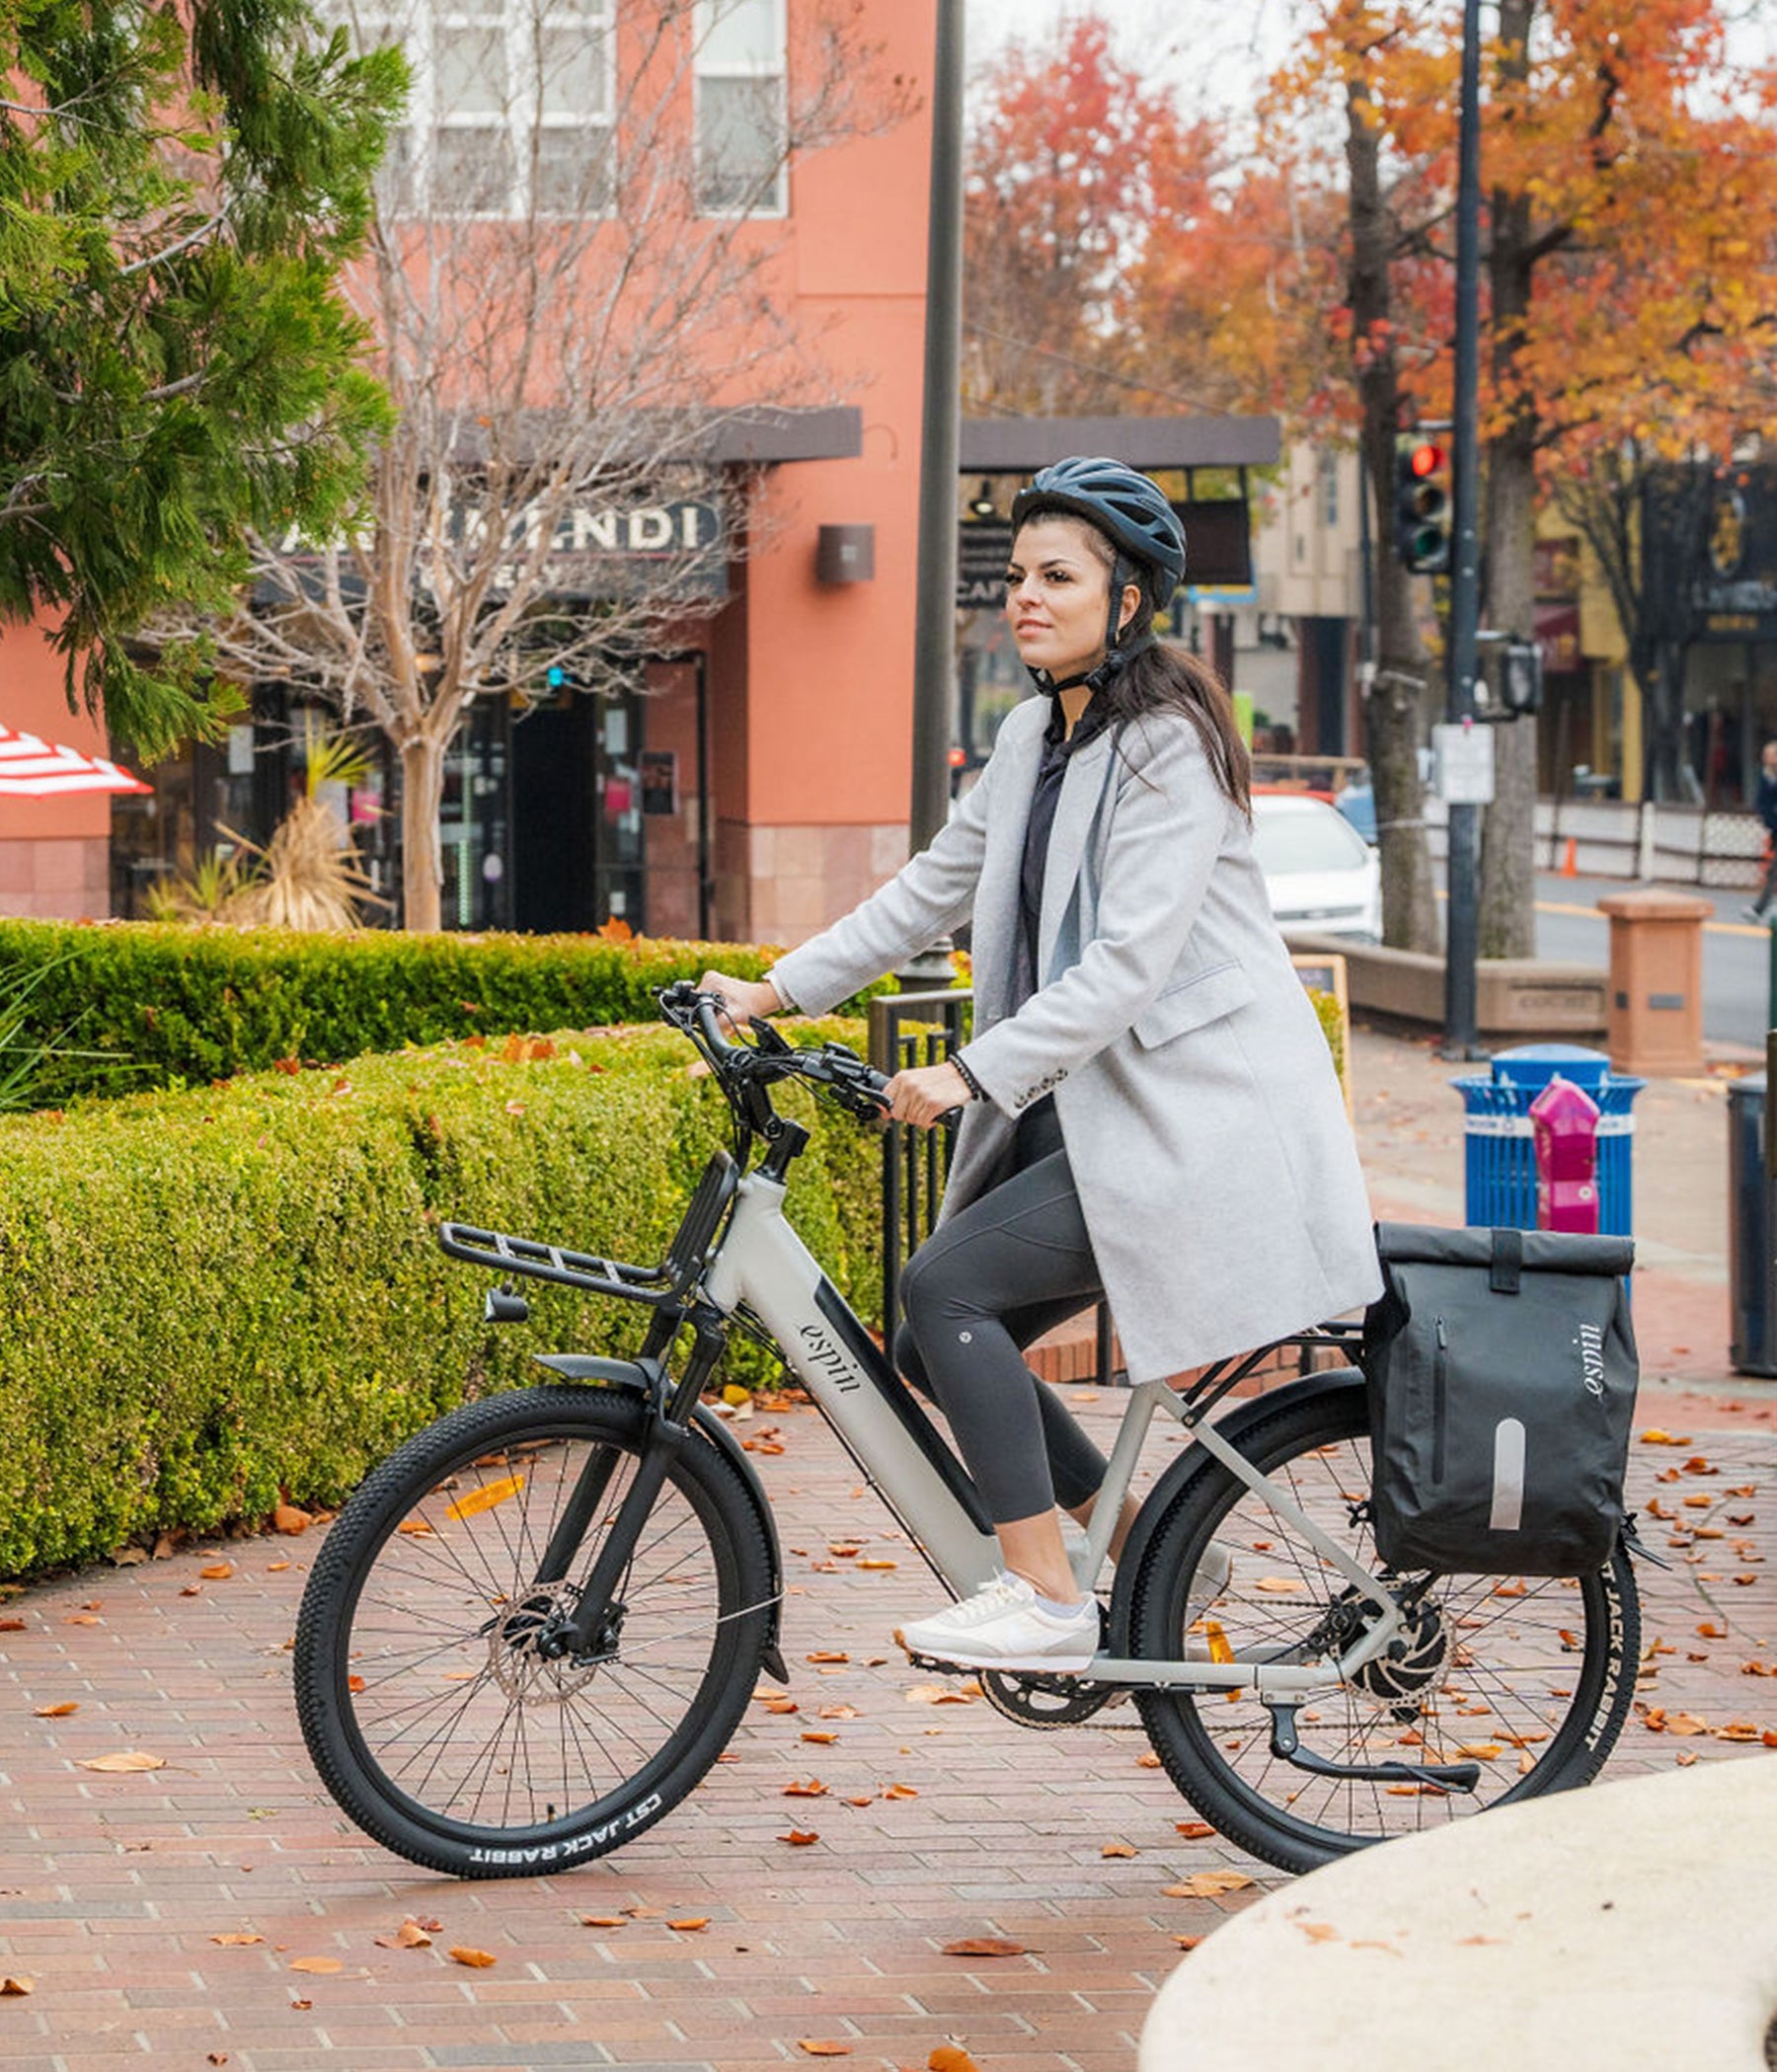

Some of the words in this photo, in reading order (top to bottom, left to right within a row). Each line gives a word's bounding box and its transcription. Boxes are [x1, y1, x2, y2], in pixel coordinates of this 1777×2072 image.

[800, 1325, 861, 1393] espin
[1572, 1323, 1604, 1398] espin
[1606, 1587, 1624, 1653] JACK
[1584, 1657, 1622, 1752] RABBIT
[563, 1824, 620, 1856] JACK
[625, 1793, 663, 1828] CST
[470, 1846, 557, 1864] RABBIT
